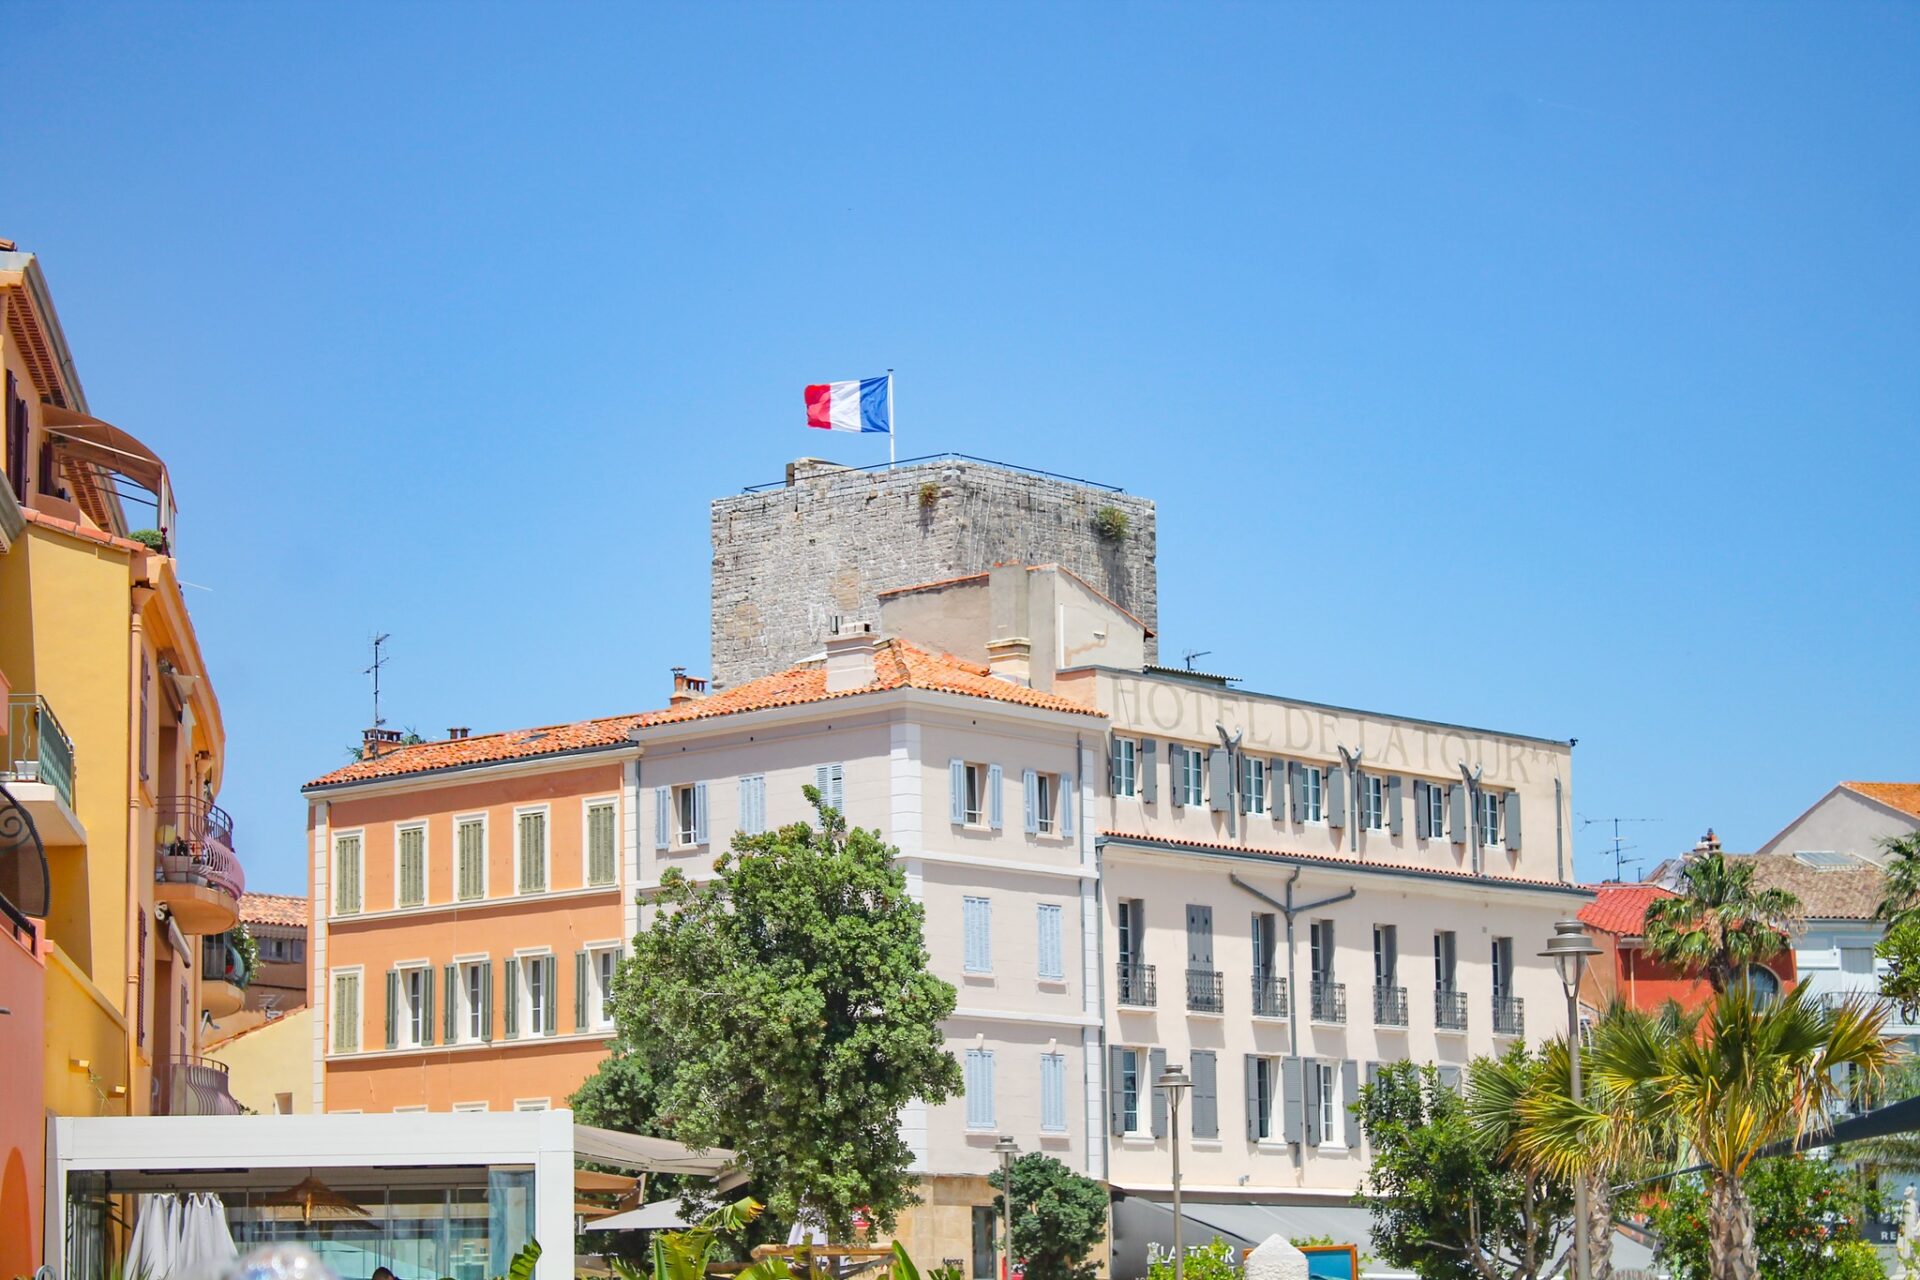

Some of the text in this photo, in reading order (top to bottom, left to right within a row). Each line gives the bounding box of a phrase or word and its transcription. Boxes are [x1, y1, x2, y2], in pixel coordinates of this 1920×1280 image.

[1111, 674, 1530, 784] HOTEL DE LA TOUR
[1187, 1245, 1236, 1264] TR
